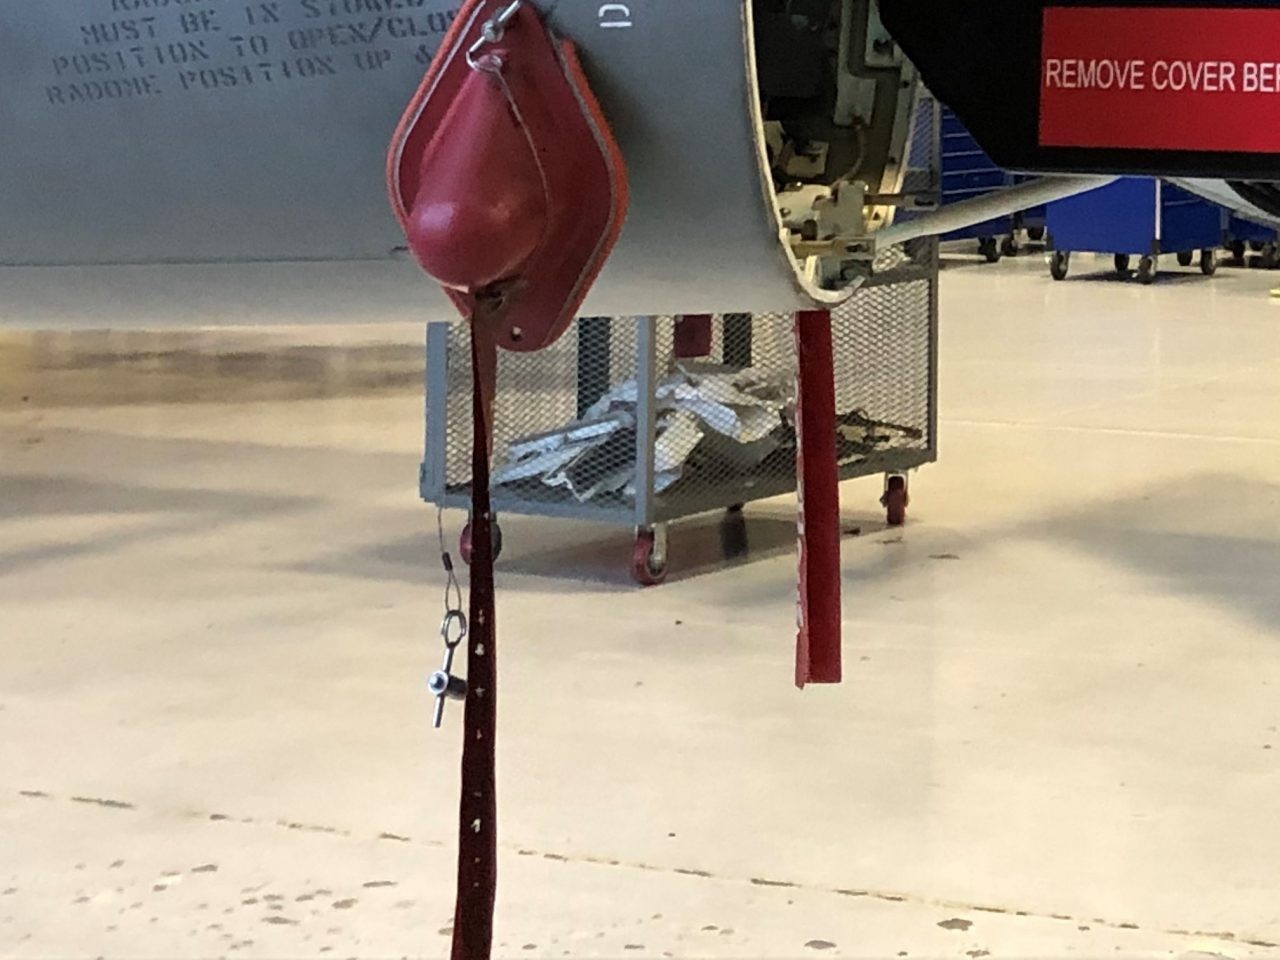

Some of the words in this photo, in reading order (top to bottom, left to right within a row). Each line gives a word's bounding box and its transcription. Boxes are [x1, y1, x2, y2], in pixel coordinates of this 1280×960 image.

[80, 16, 155, 45] MUST
[180, 8, 221, 34] BE
[245, 1, 280, 25] IN
[52, 39, 210, 75] POSITION
[229, 35, 269, 58] TO
[1046, 58, 1145, 89] REMOVE
[1151, 60, 1236, 91] COVER
[46, 75, 162, 104] RADOME
[179, 55, 337, 90] POSITION
[354, 49, 391, 71] UP
